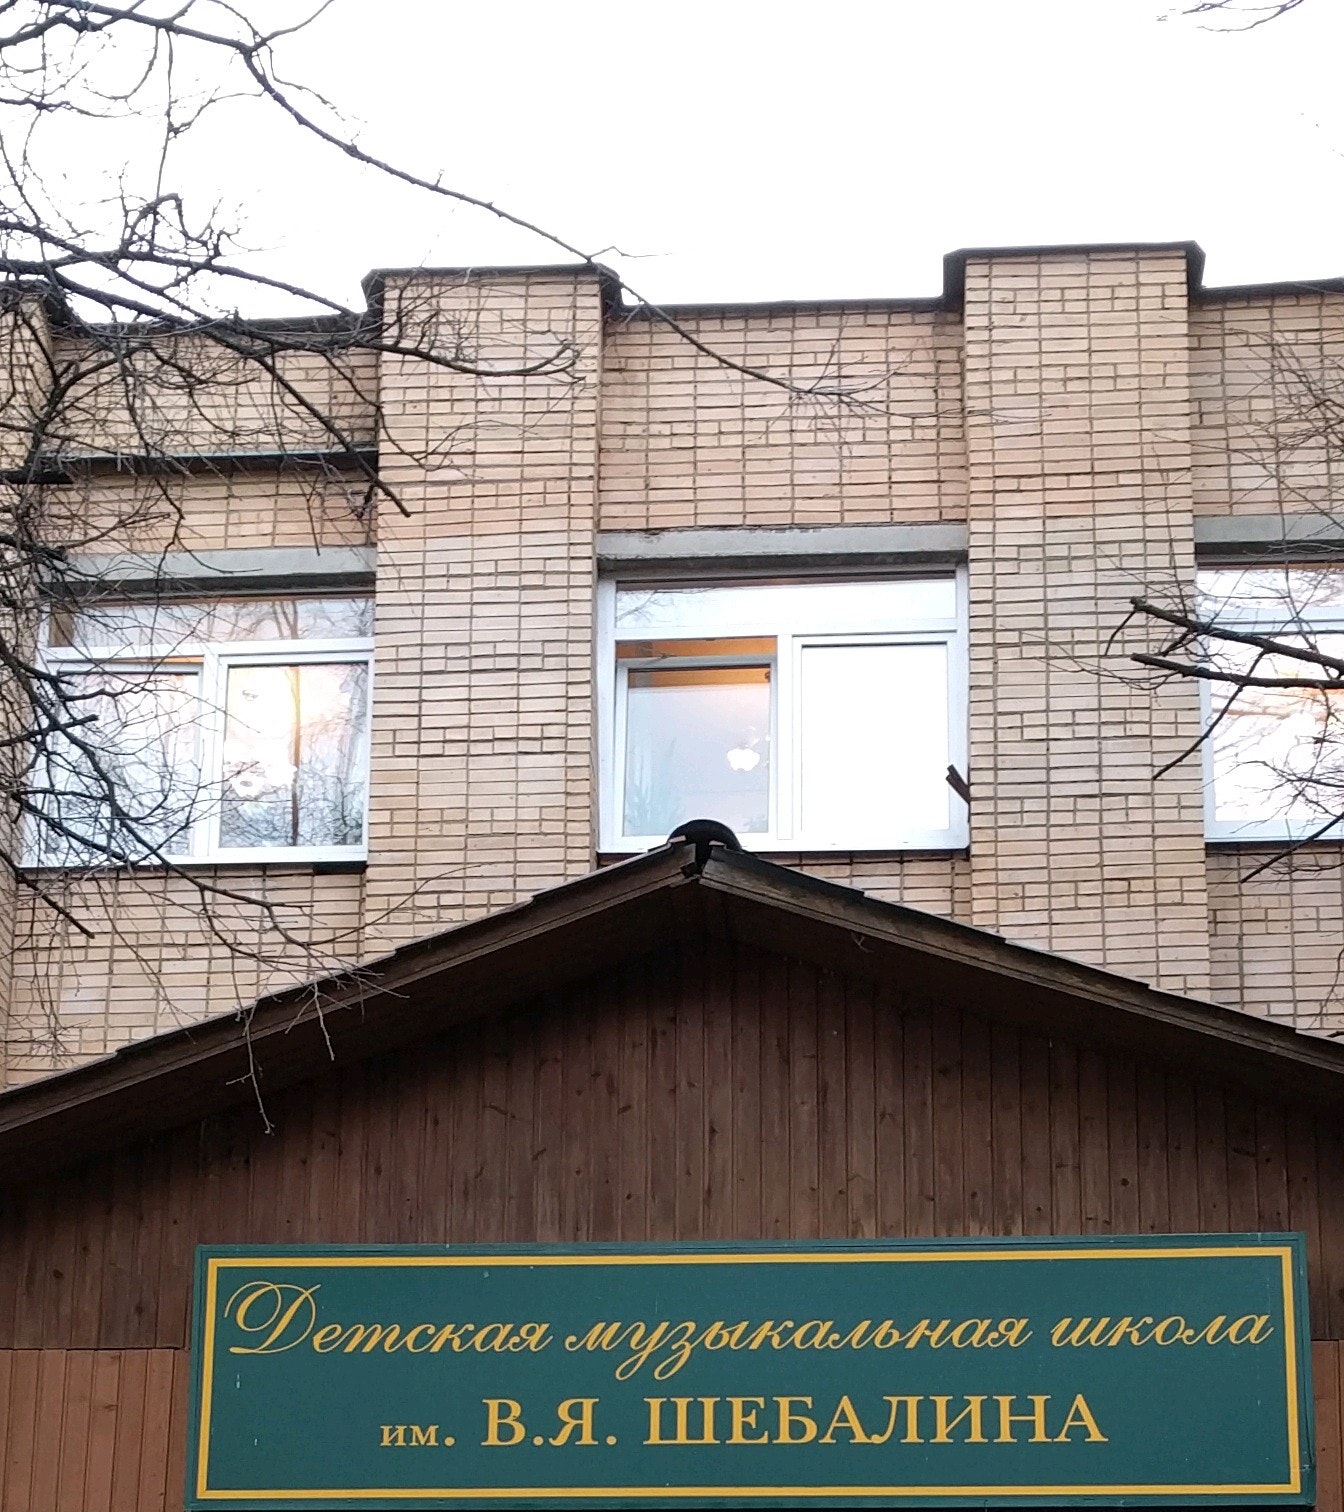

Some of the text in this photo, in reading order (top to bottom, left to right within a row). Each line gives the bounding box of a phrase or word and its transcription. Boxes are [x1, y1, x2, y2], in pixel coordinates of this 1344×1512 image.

[224, 1280, 1274, 1381] Детская музыкальная школа
[379, 1393, 1109, 1447] им. В.Я. ШЕБАЛИНА
